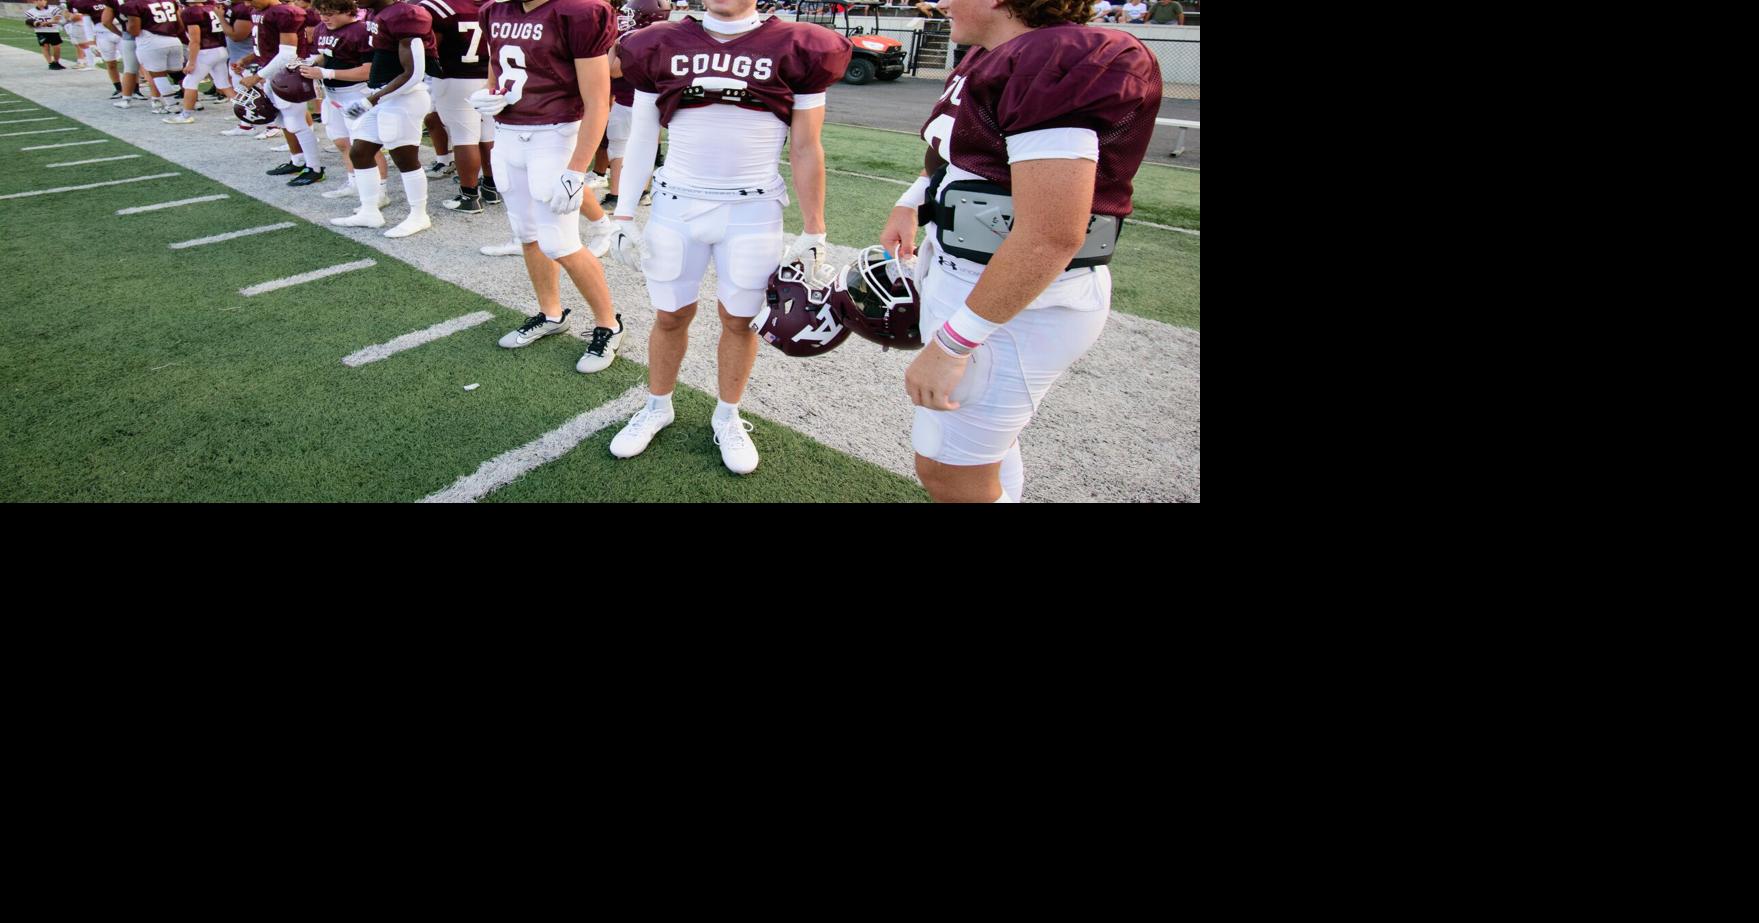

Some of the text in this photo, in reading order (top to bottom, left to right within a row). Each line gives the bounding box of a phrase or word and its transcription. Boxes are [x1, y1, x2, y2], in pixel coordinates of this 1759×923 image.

[148, 1, 178, 24] 52
[458, 21, 482, 63] 7
[491, 22, 544, 41] COUGS
[499, 44, 528, 105] 6
[671, 53, 773, 80] COUGS
